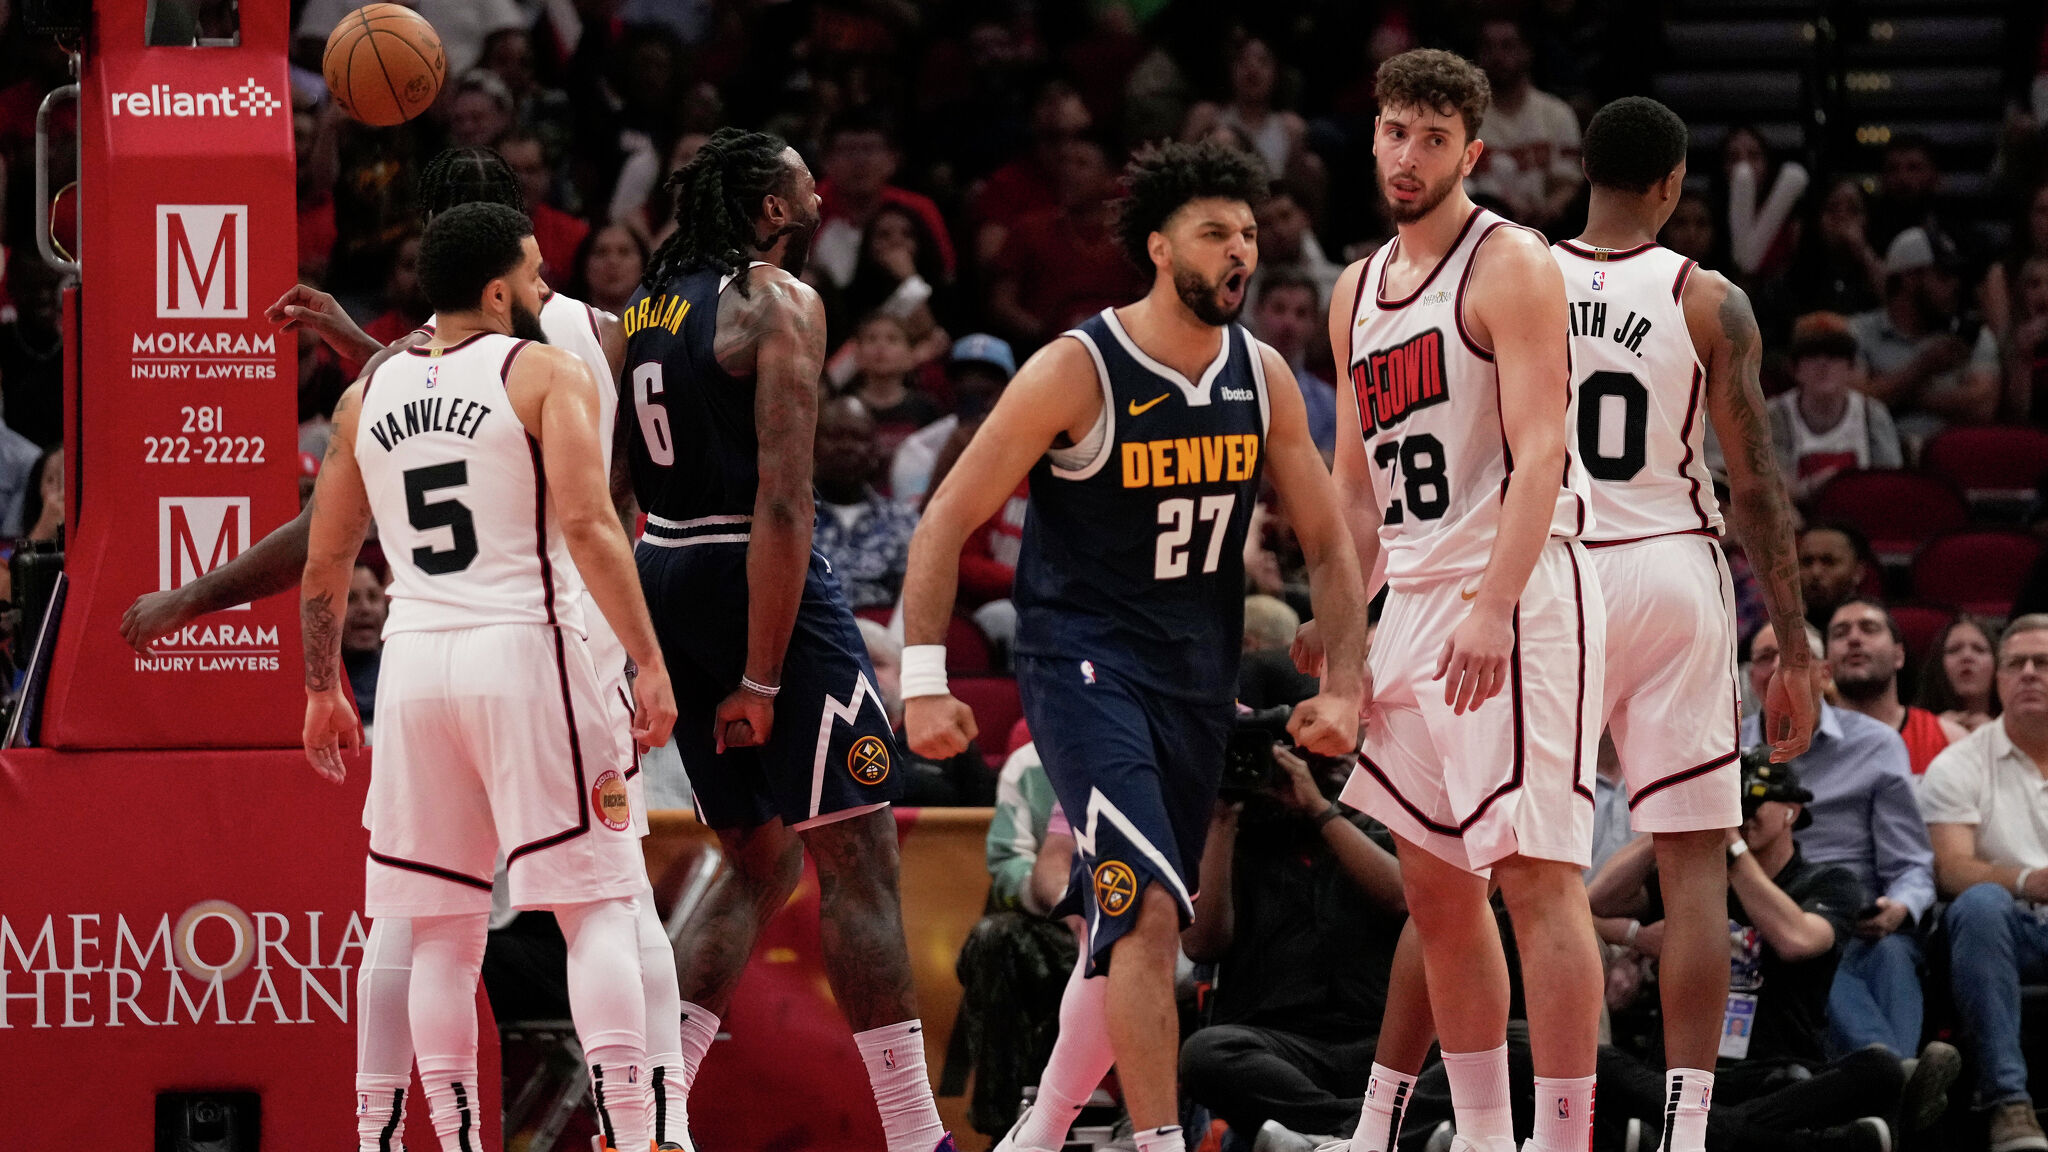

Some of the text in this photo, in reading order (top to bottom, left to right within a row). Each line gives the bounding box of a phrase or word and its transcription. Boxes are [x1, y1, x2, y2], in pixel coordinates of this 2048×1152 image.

[112, 84, 239, 117] reliant
[624, 293, 691, 338] ORDAN
[1569, 302, 1652, 359] ITH JR.
[132, 332, 276, 354] MOKARAM
[131, 364, 277, 379] INJURY LAWYERS
[1221, 386, 1254, 401] ibotta
[181, 406, 222, 433] 281
[370, 397, 491, 453] VANVLEET
[633, 360, 675, 467] 6
[1577, 369, 1649, 482] 0
[144, 436, 265, 463] 222-2222
[1121, 434, 1259, 488] DENVER
[1374, 433, 1450, 525] 28
[403, 459, 480, 576] 5
[1154, 494, 1236, 580] 27
[151, 624, 279, 646] OKARAM
[134, 656, 280, 672] INJURY LAWYERS
[0, 911, 370, 974] MEMORIA
[0, 967, 353, 1029] HERMAN
